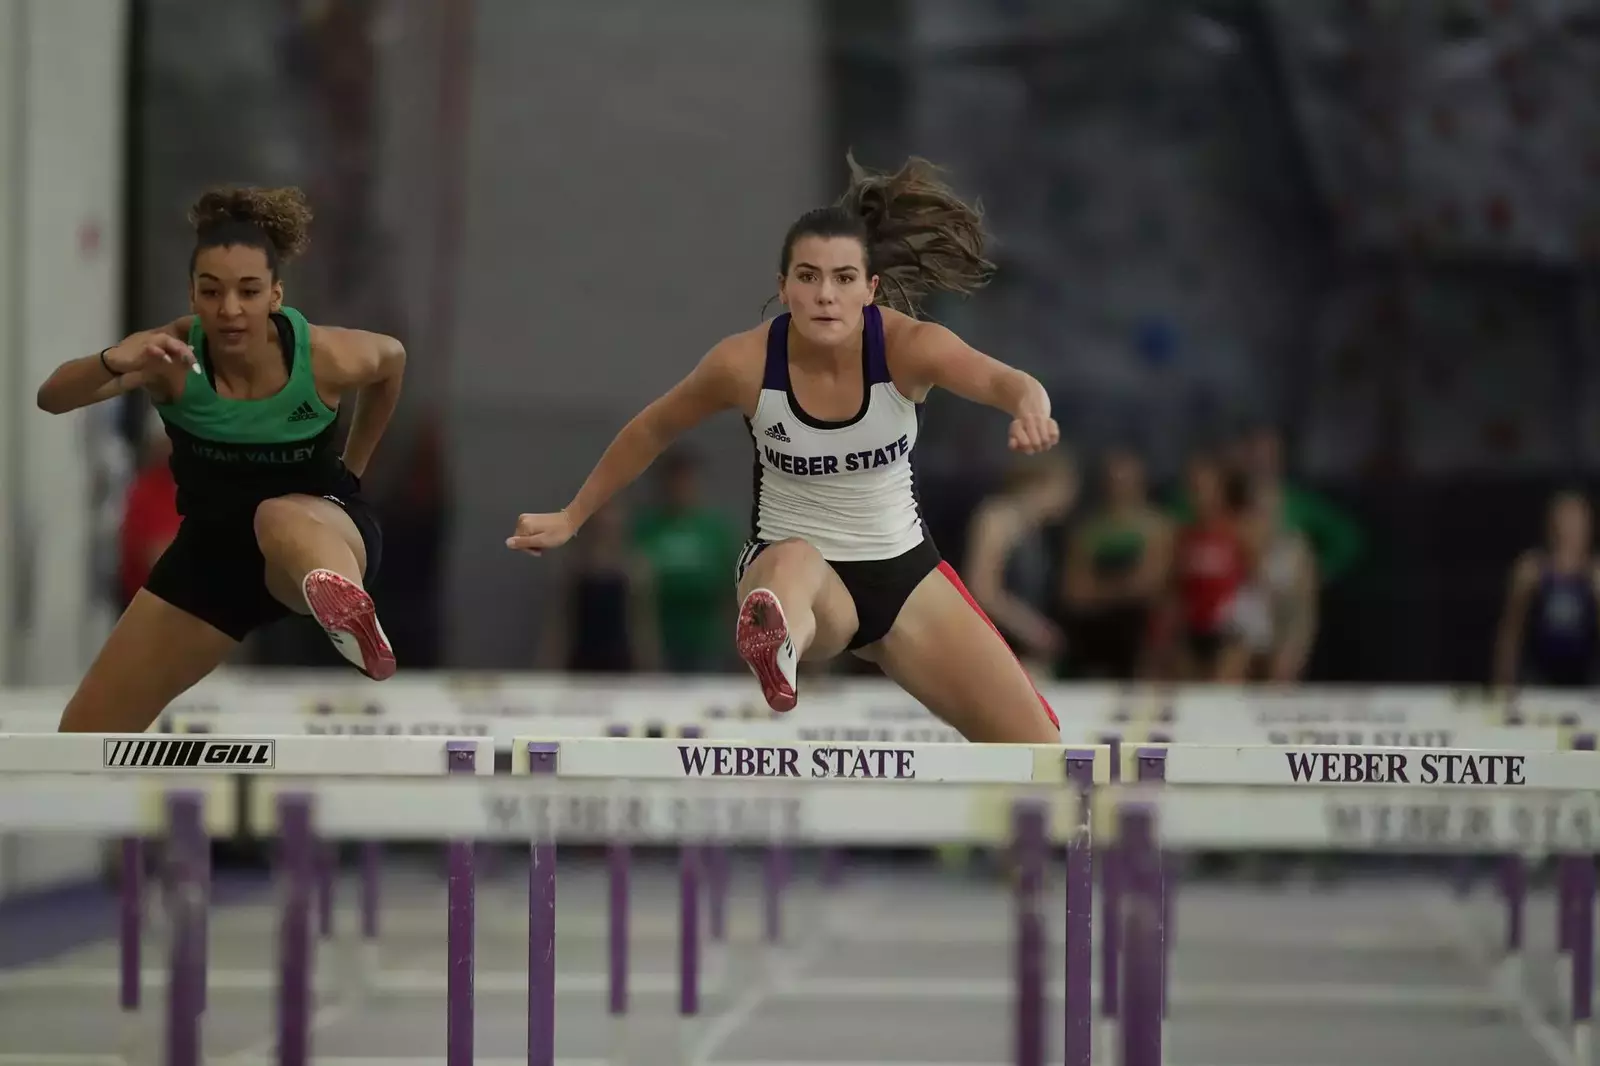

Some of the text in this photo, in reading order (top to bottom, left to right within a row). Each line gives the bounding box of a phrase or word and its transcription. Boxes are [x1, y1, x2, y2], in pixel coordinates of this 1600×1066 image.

[764, 429, 791, 443] adidas
[192, 443, 316, 464] UTAH VALLEY
[764, 434, 909, 476] WEBER STATE
[204, 744, 269, 764] GILL
[677, 746, 916, 779] WEBER STATE
[1285, 752, 1526, 786] WEBER STATE
